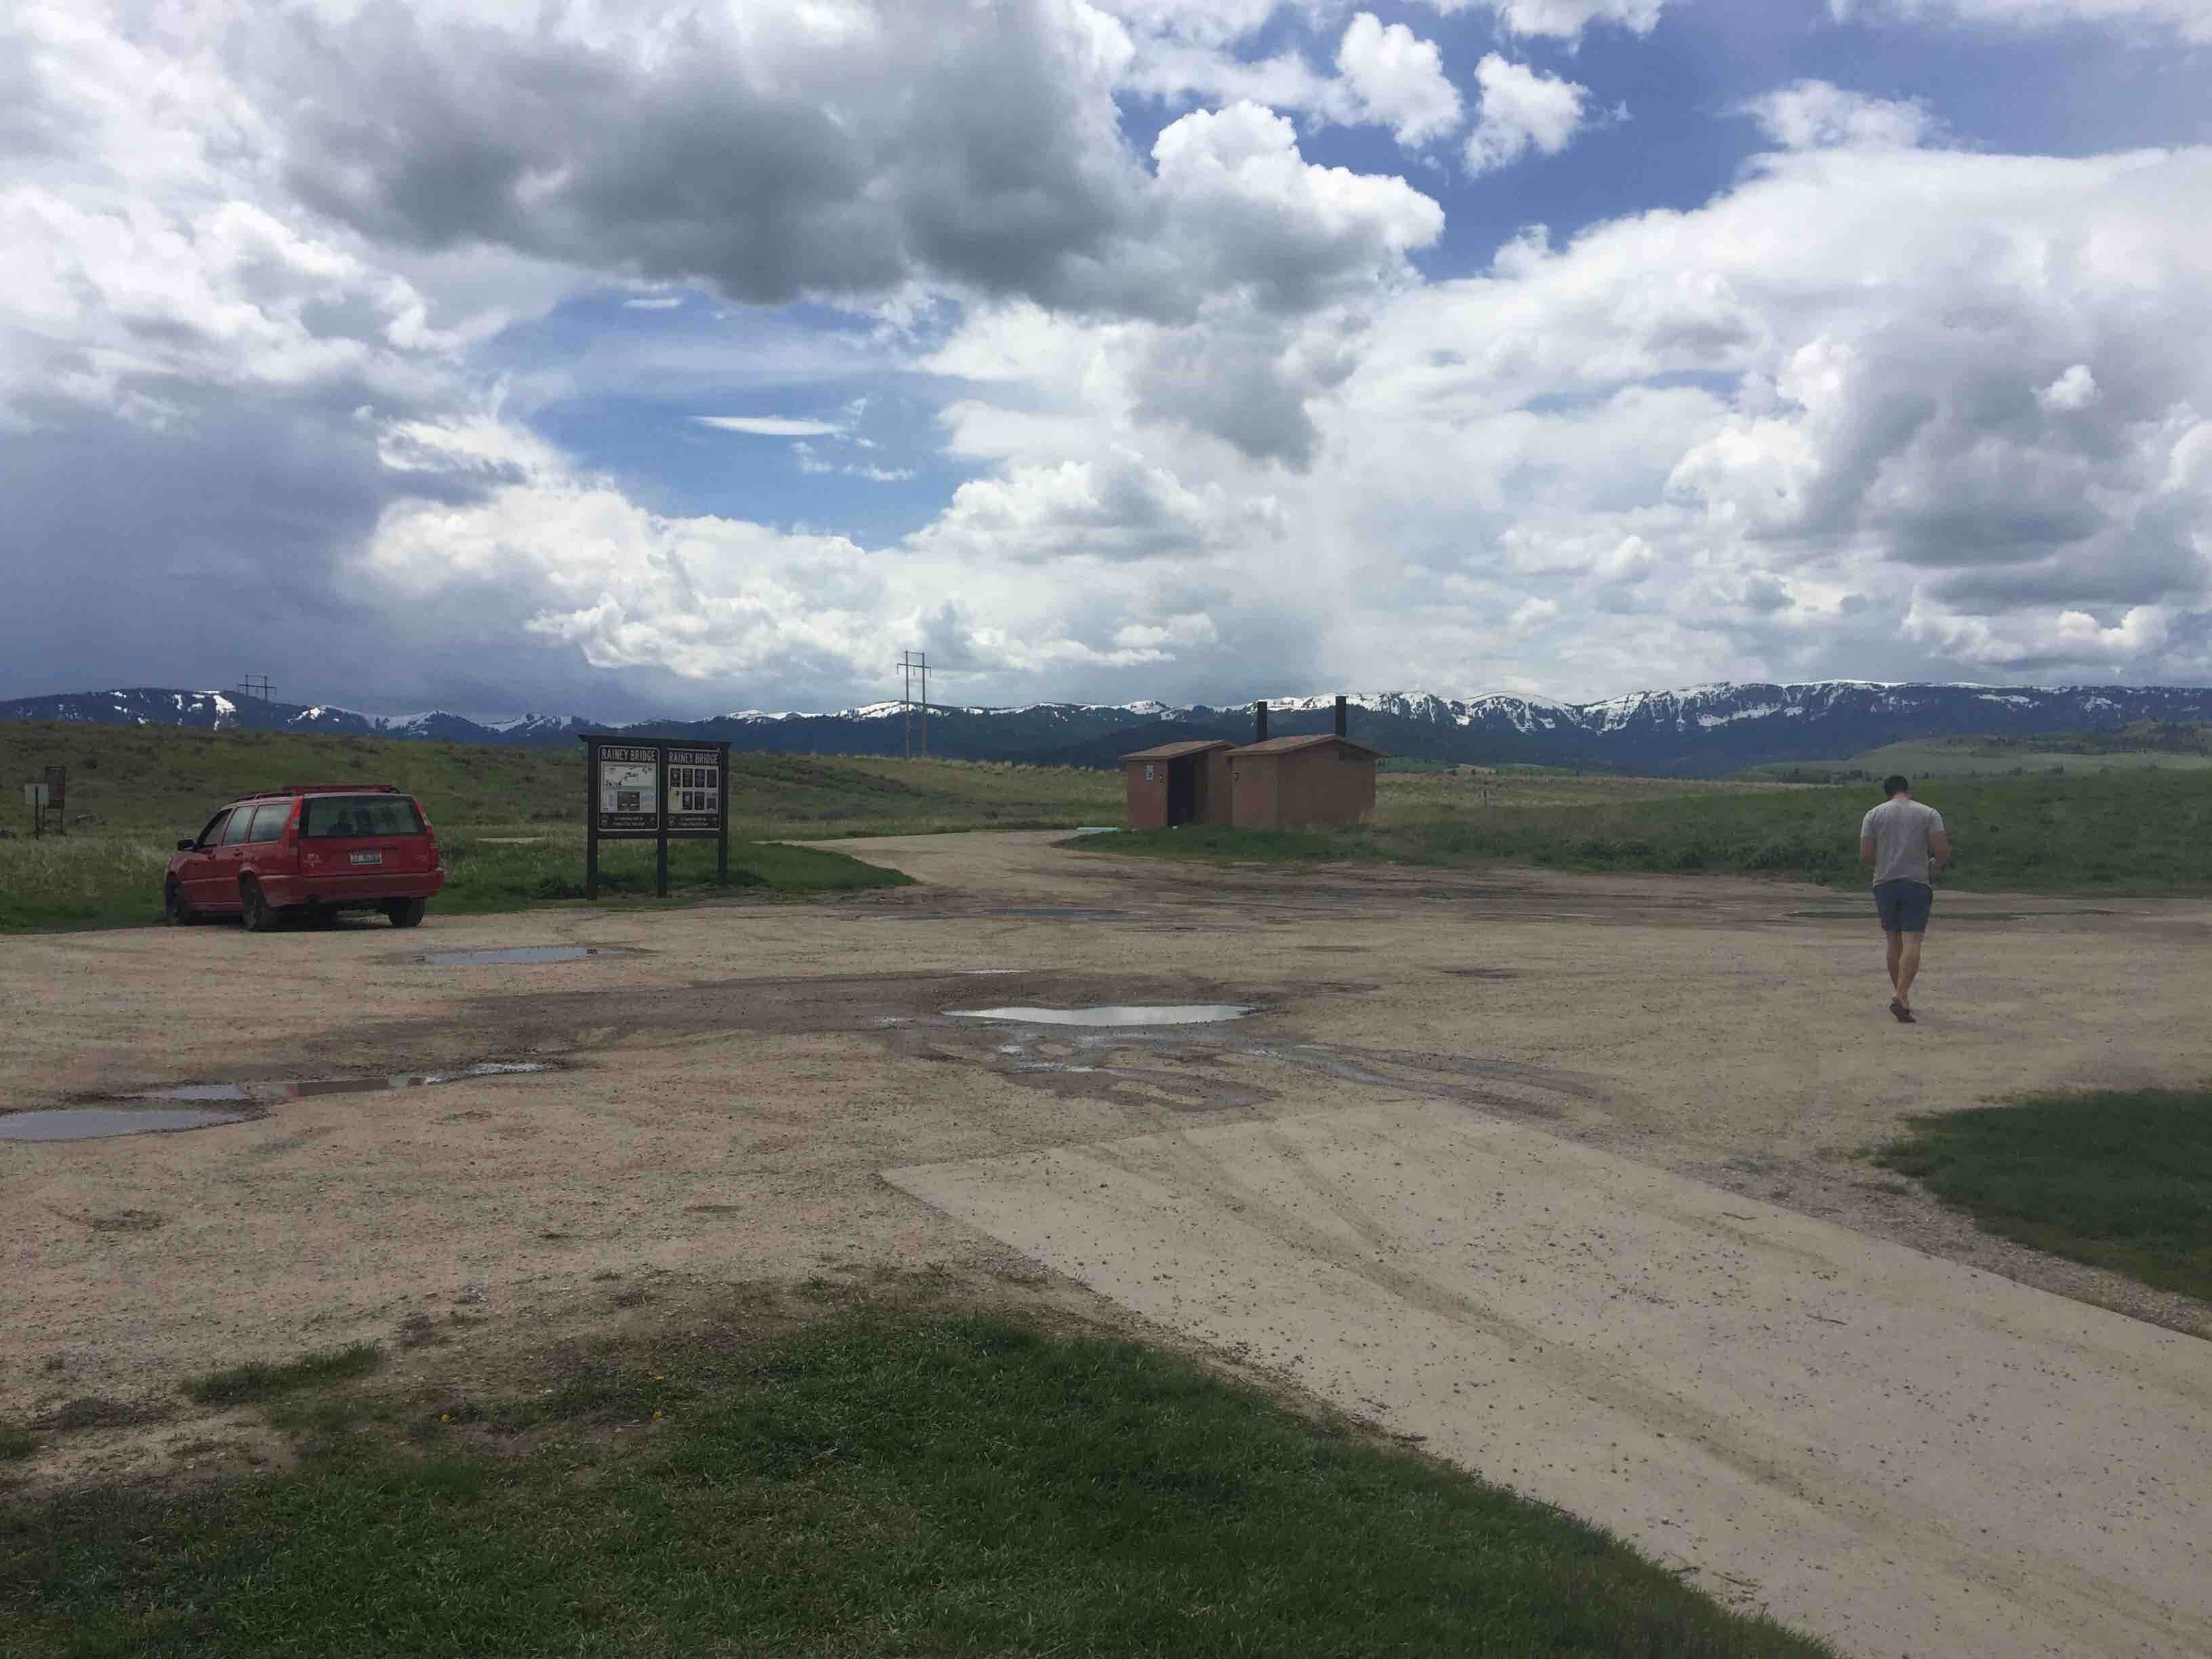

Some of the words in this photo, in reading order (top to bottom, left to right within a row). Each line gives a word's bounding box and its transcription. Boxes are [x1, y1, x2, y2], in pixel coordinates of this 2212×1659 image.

[601, 748, 628, 760] RAINEY
[630, 749, 656, 761] BRIDGE
[668, 752, 693, 764] RAINEY
[695, 753, 718, 764] BRIDGE
